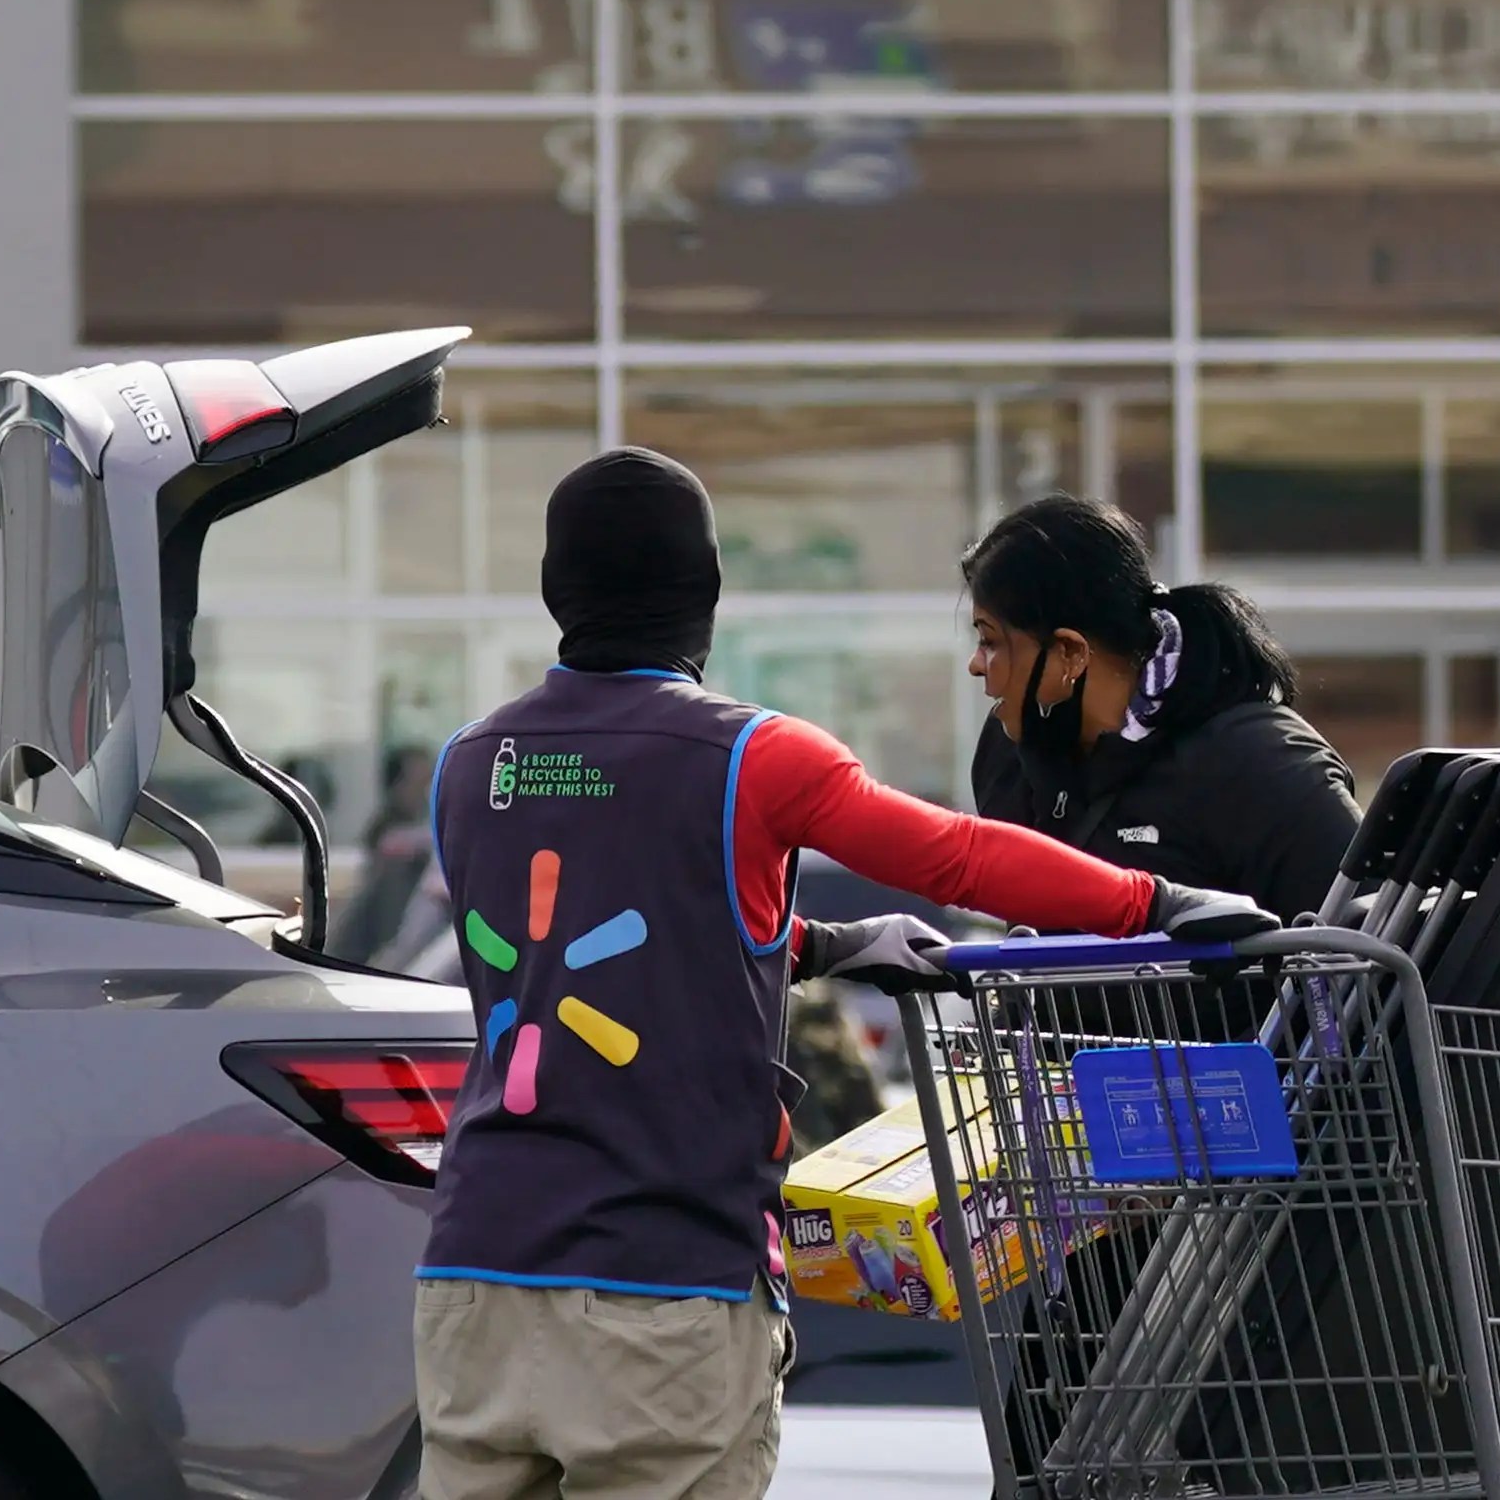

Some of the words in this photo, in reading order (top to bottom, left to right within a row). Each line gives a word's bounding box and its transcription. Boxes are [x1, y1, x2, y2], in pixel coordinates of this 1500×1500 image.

[521, 755, 529, 766] 6
[531, 754, 582, 766] BOTTLES
[520, 768, 581, 781] RECYCLED
[585, 768, 601, 781] TO
[517, 783, 552, 796] MAKE
[555, 783, 582, 796] THIS
[584, 783, 615, 796] VEST
[792, 1216, 832, 1246] HUG
